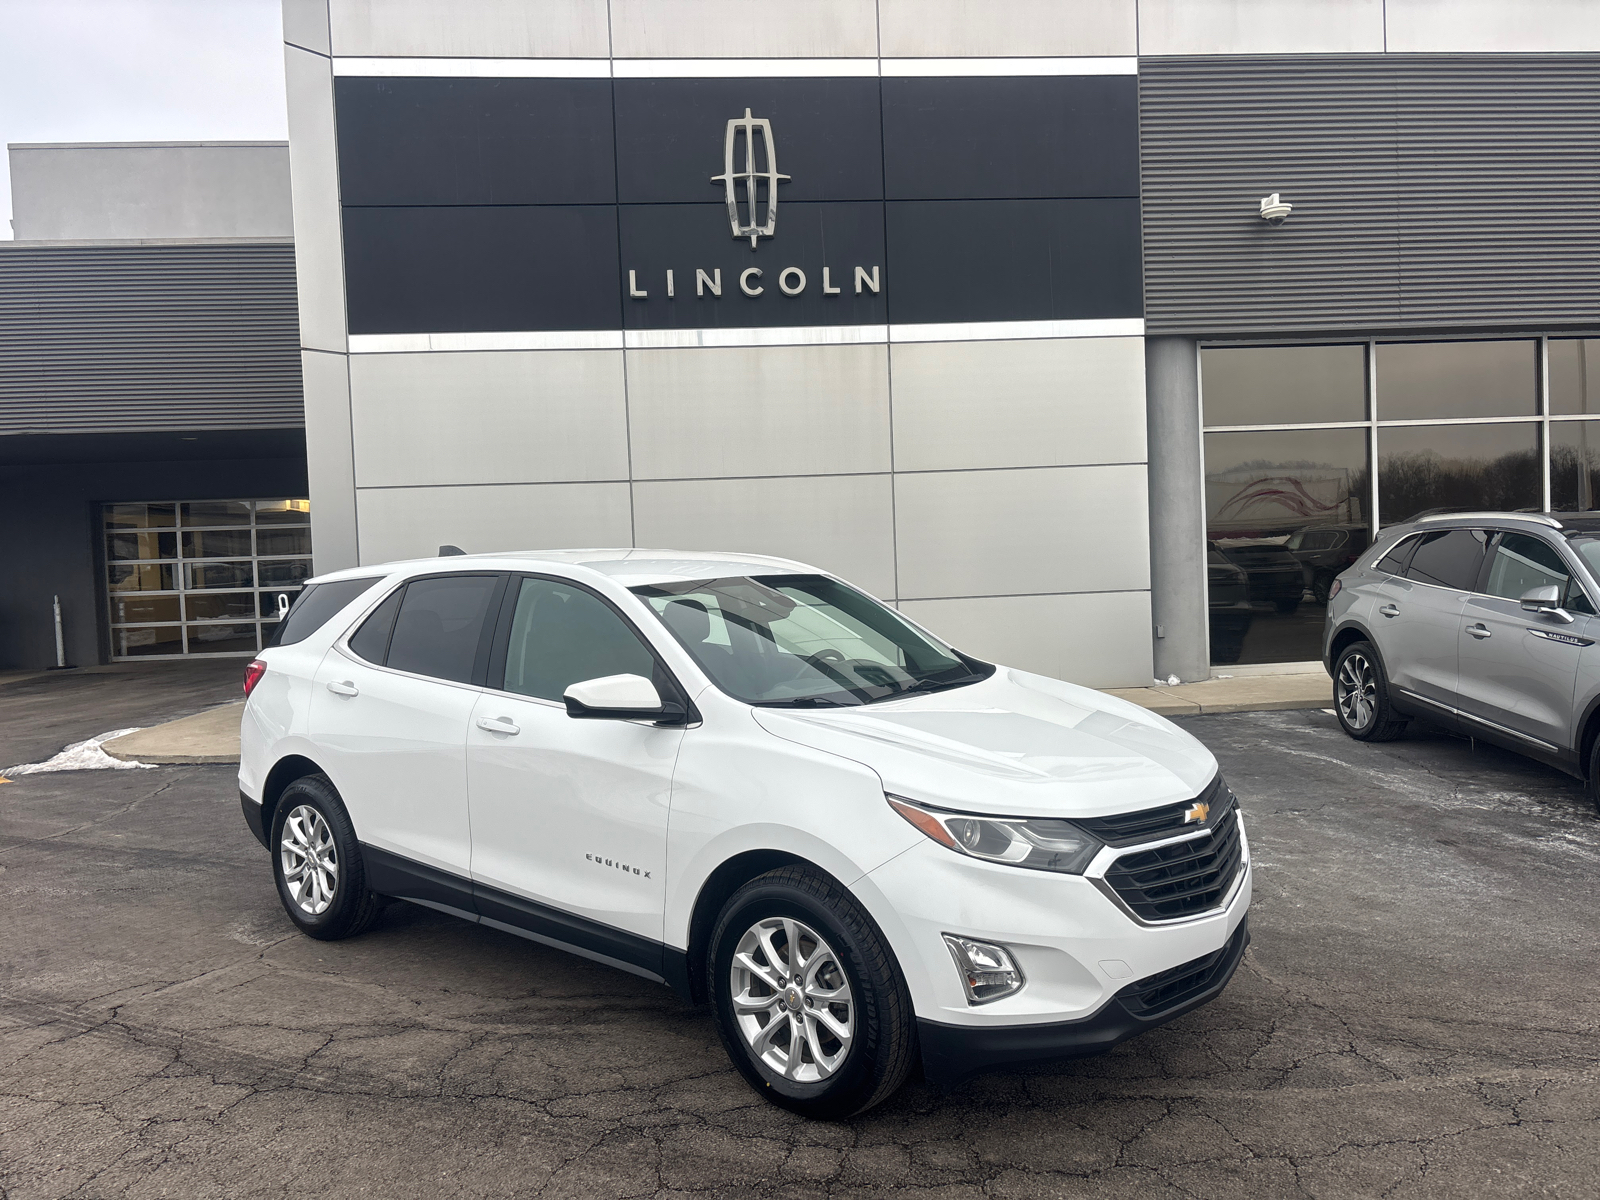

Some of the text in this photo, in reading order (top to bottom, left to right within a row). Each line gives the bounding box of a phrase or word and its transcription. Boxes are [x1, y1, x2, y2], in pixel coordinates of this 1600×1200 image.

[629, 265, 880, 299] LINCOLN
[1548, 633, 1578, 643] NAUTILUS
[585, 853, 651, 879] EQUINOX
